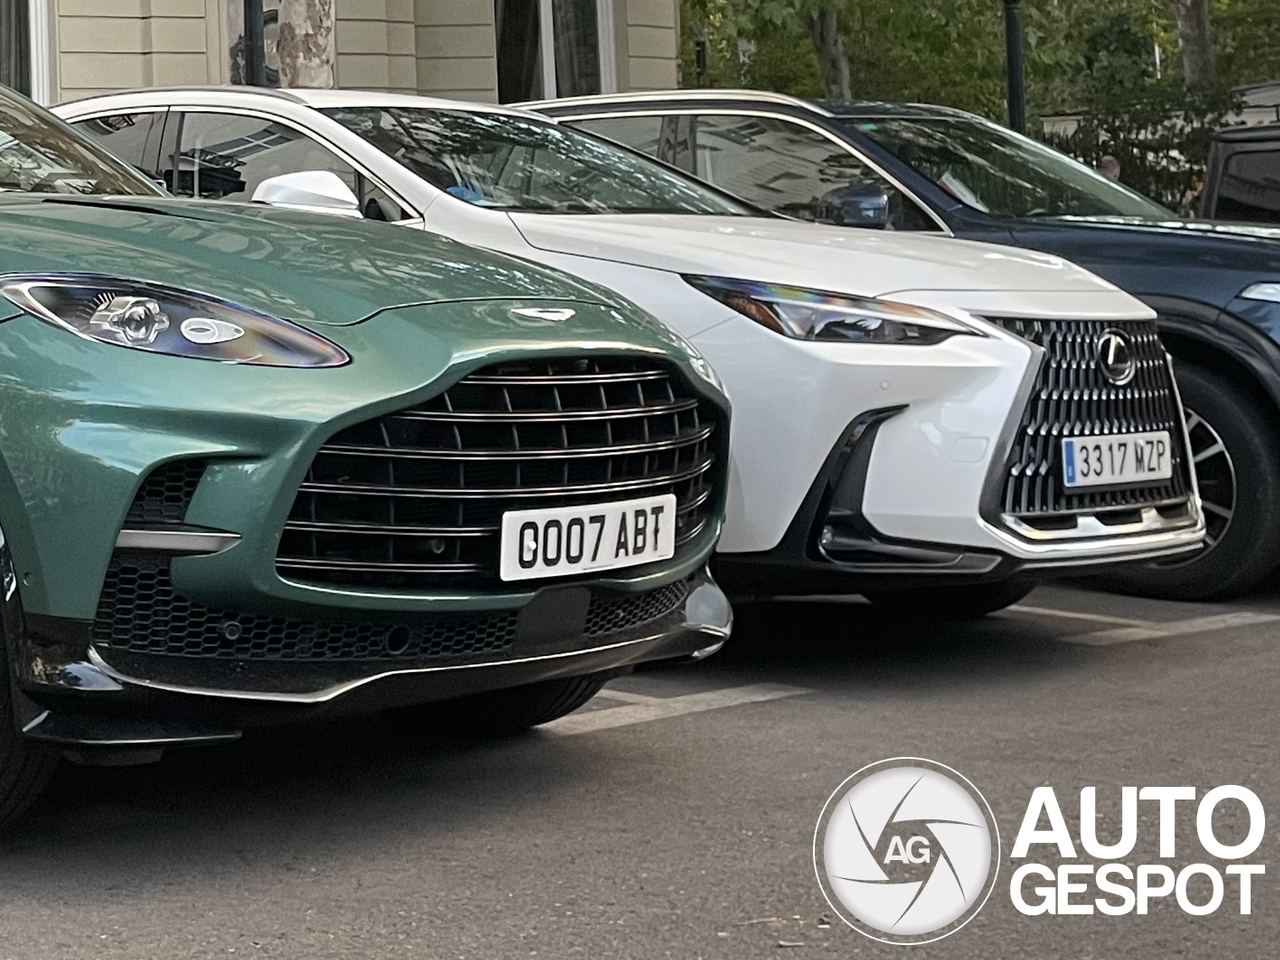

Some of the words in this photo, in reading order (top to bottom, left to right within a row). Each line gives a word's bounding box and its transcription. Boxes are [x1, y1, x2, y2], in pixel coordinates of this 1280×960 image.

[1080, 443, 1127, 477] 3317
[1134, 440, 1166, 473] MZP
[614, 505, 665, 558] ABT
